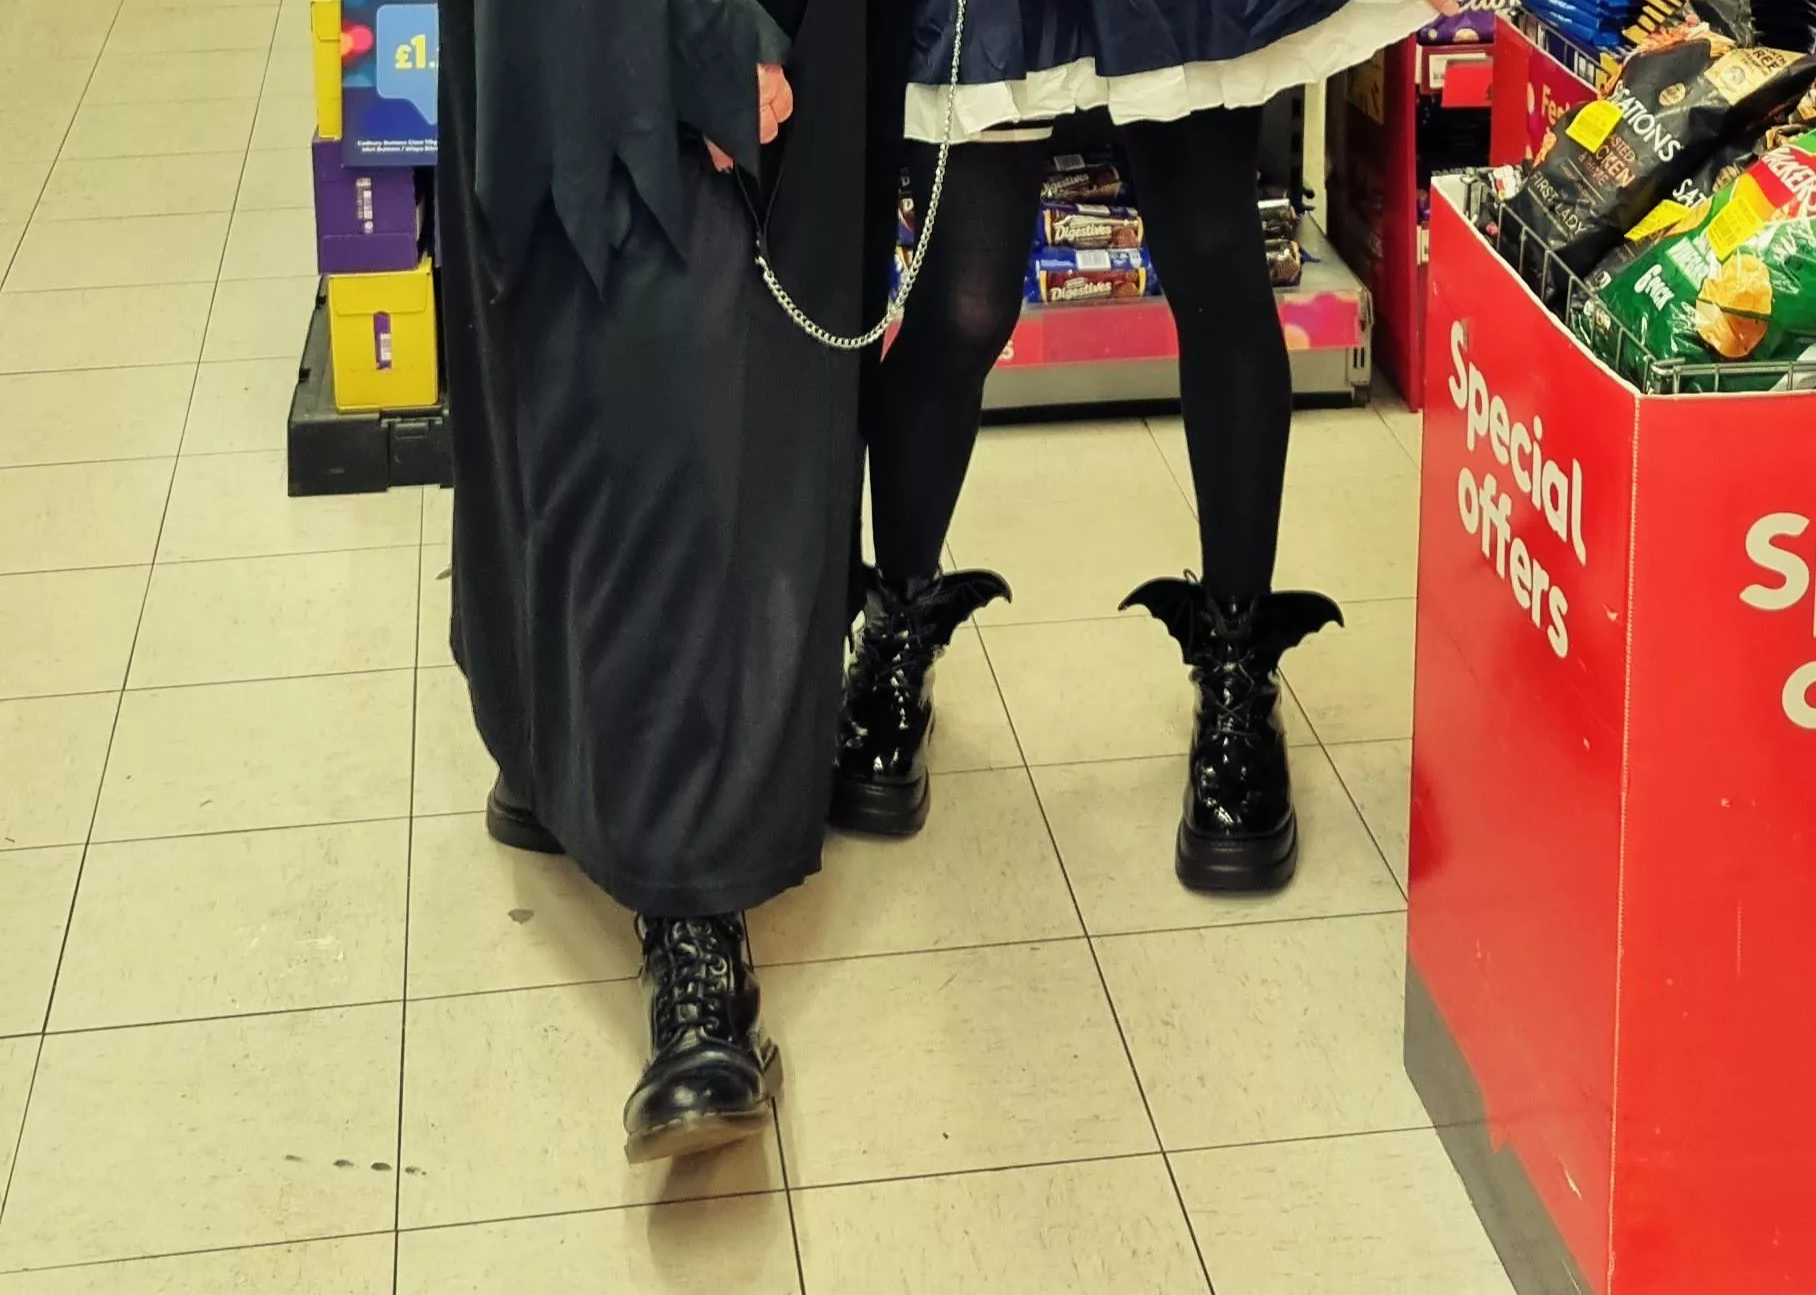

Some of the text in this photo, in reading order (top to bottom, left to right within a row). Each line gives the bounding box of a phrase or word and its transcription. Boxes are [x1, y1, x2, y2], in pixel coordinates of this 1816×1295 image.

[1530, 171, 1559, 202] FIRST
[1054, 225, 1112, 242] Digestives
[1555, 204, 1587, 237] LADY
[1050, 281, 1112, 301] Digestives
[1448, 320, 1586, 566] Special
[1458, 467, 1569, 658] offers
